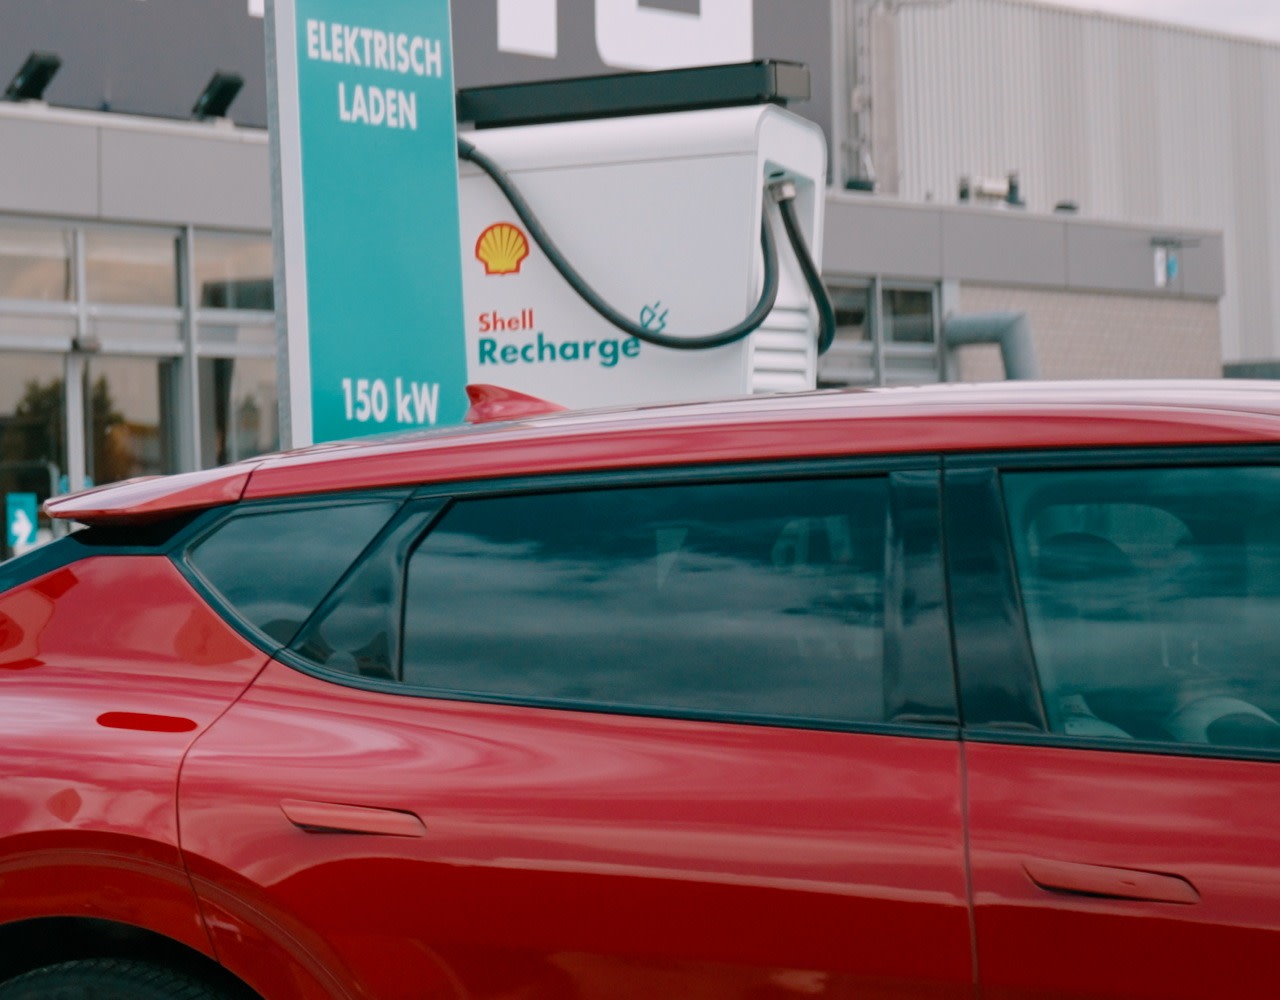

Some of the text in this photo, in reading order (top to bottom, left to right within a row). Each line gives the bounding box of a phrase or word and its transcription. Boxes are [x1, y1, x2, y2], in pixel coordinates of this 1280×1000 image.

[307, 19, 442, 78] ELEKTRISCH
[338, 81, 417, 130] LADEN
[478, 309, 534, 332] Shell
[478, 333, 640, 367] Recharge
[342, 377, 439, 425] 150 kW
